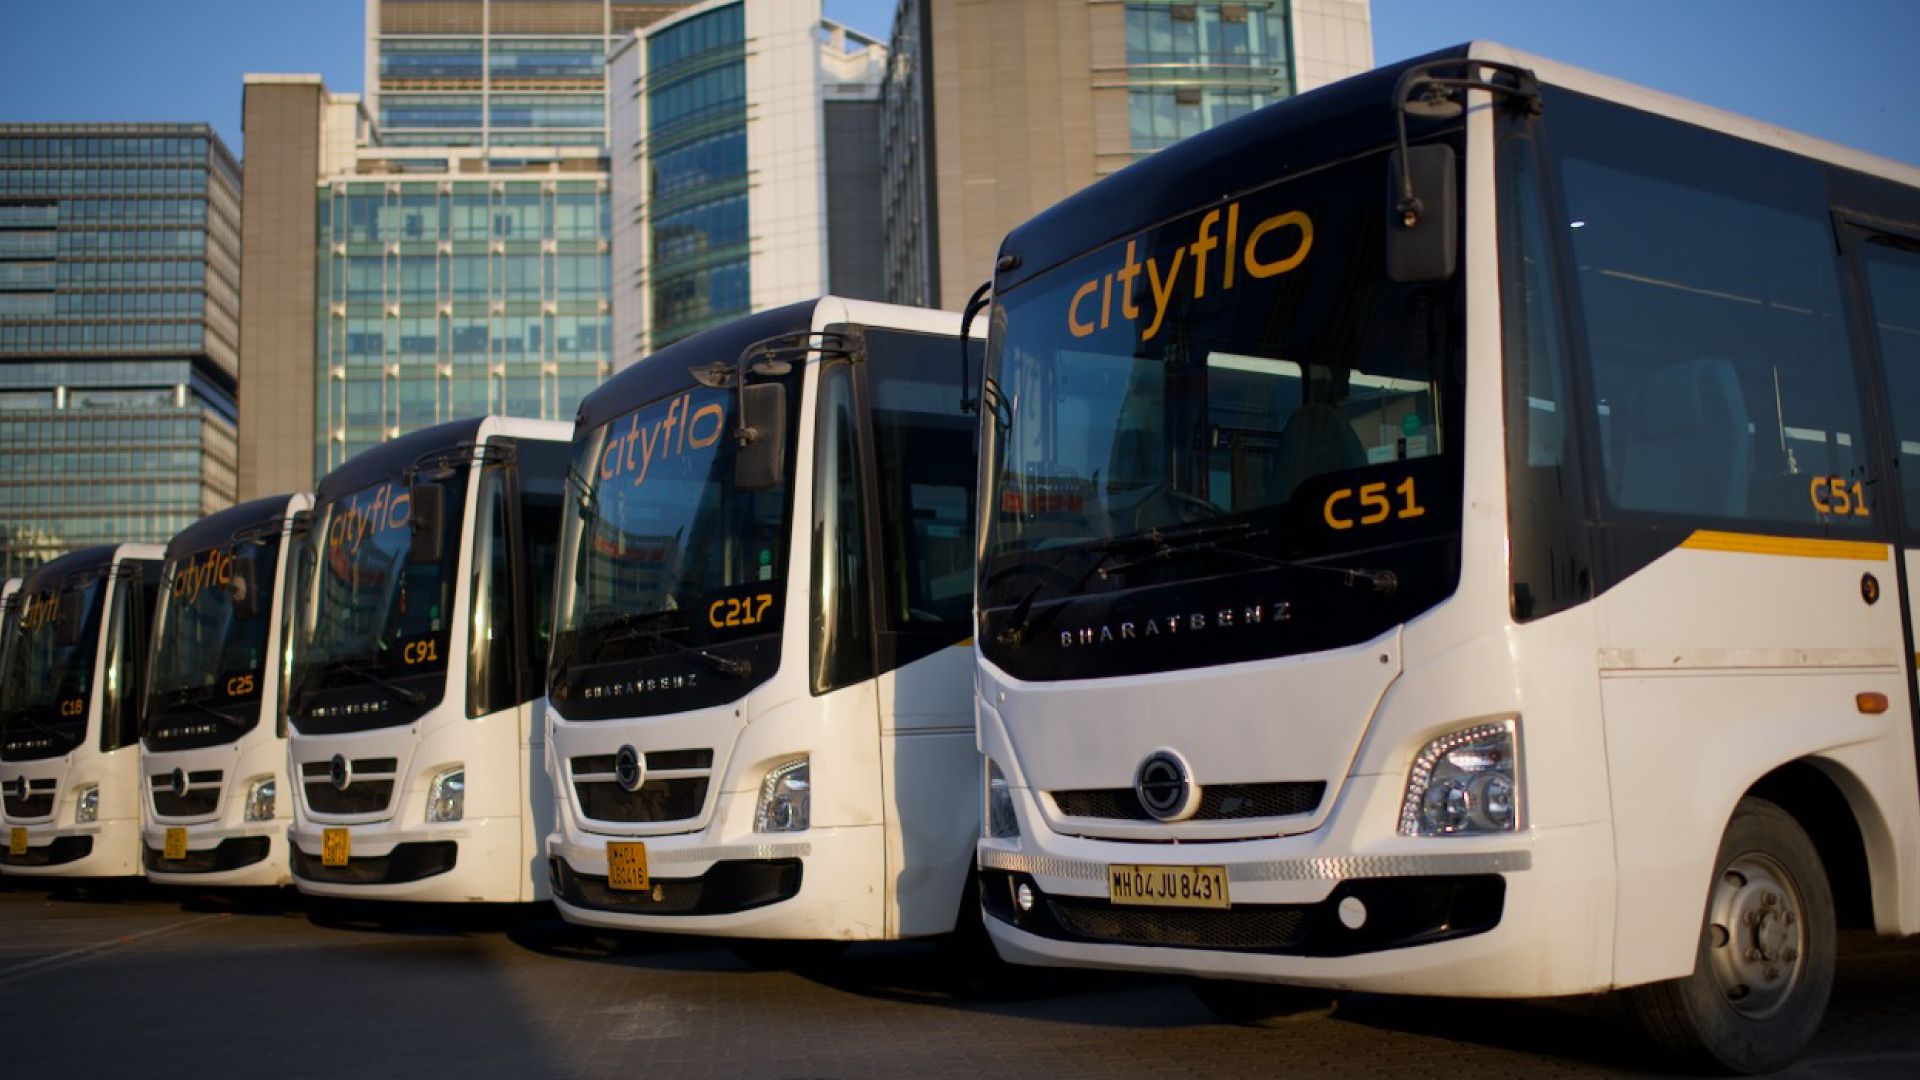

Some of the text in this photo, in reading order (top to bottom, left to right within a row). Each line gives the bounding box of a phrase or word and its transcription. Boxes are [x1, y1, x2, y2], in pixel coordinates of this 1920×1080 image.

[1068, 202, 1314, 341] cityflo
[600, 394, 724, 486] cityflo
[1323, 476, 1425, 529] C51
[1809, 476, 1869, 516] C51
[709, 594, 773, 628] C217
[1061, 602, 1290, 647] BHARATBENZ
[404, 640, 438, 664] C91
[227, 676, 255, 696] C25
